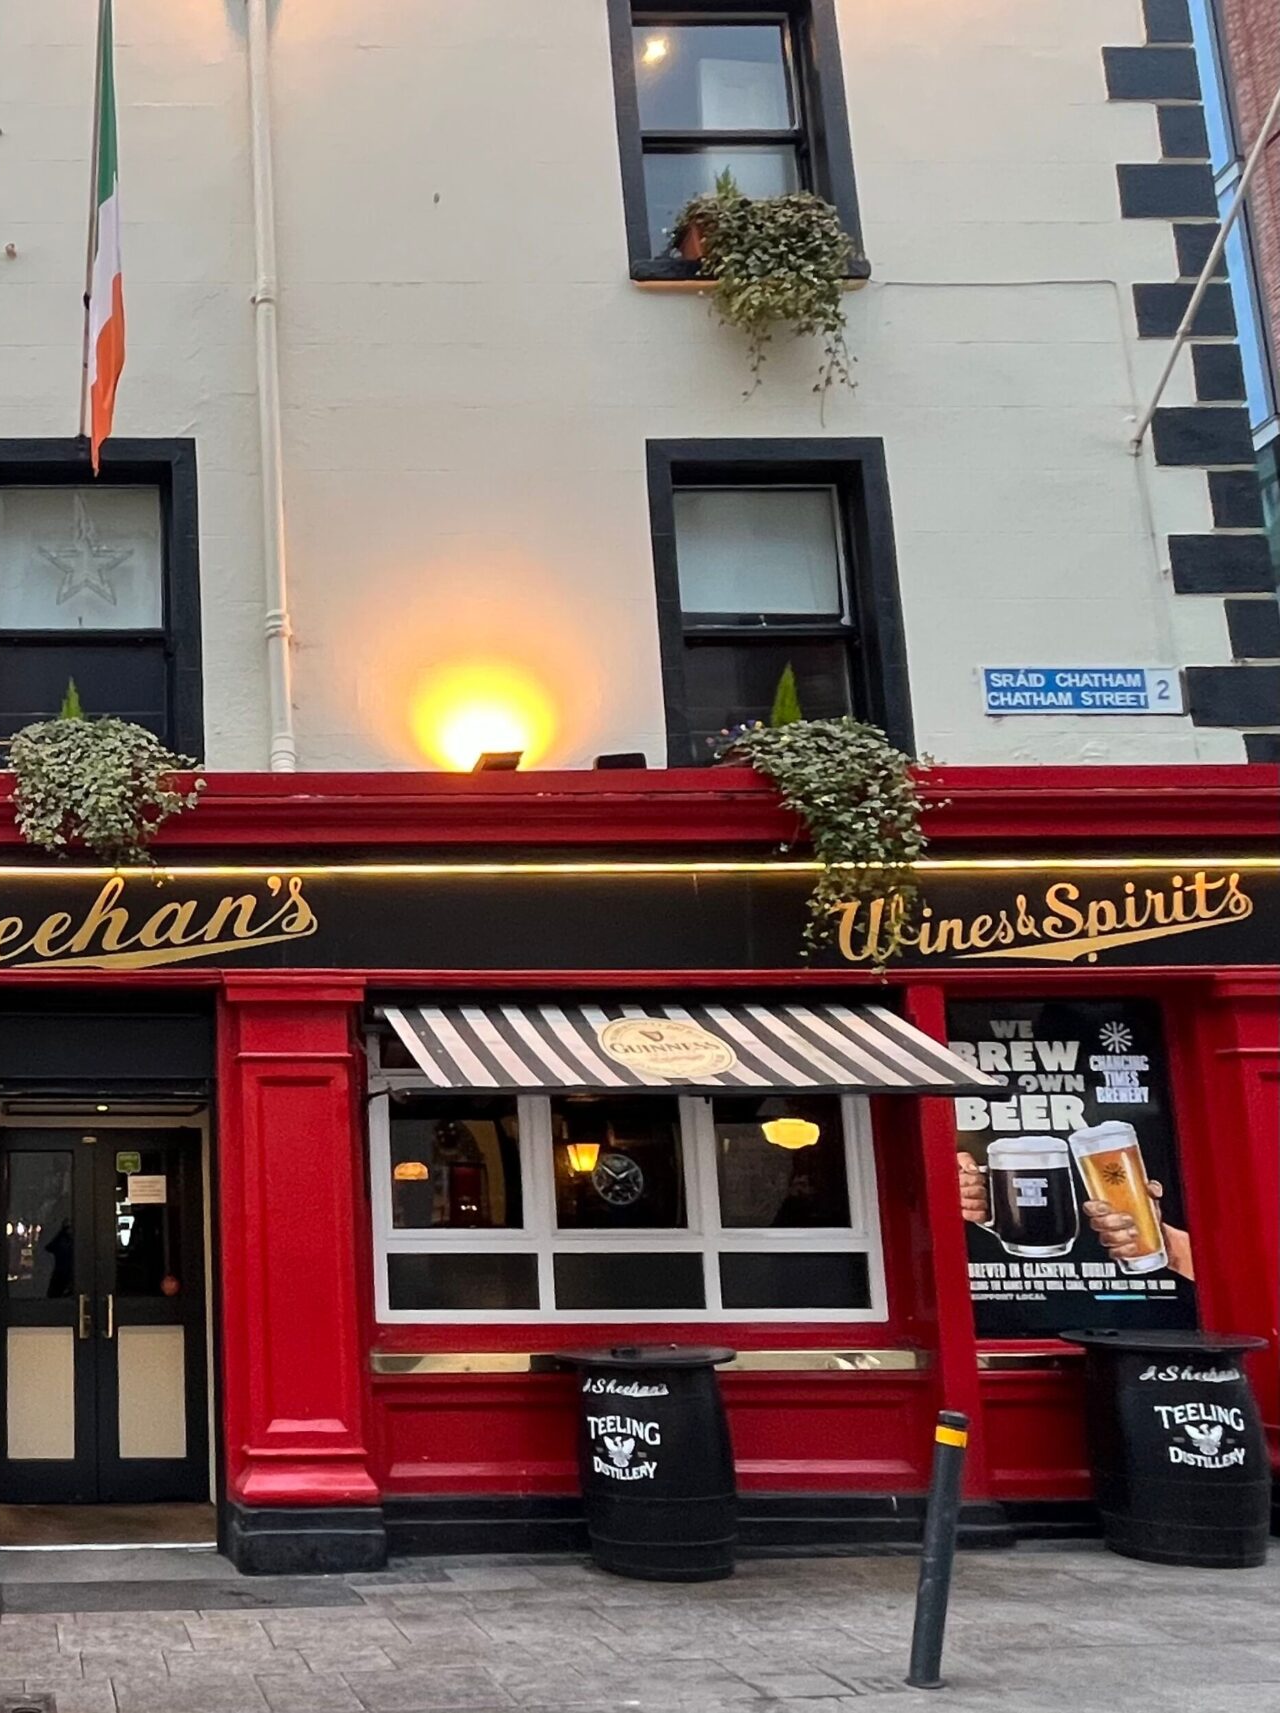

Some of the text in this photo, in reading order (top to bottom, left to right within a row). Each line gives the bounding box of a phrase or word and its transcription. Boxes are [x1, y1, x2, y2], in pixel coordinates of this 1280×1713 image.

[989, 667, 1142, 688] SRÁID CHATHAM
[988, 692, 1149, 707] CHATHAM STREET
[1156, 679, 1170, 700] 2
[989, 1020, 1034, 1038] WE
[954, 1094, 1090, 1131] BEER
[1153, 1402, 1245, 1431] TEELING
[587, 1415, 661, 1446] TEELING
[593, 1456, 658, 1481] DISTILLERY
[1169, 1446, 1246, 1469] DISTILLERY
